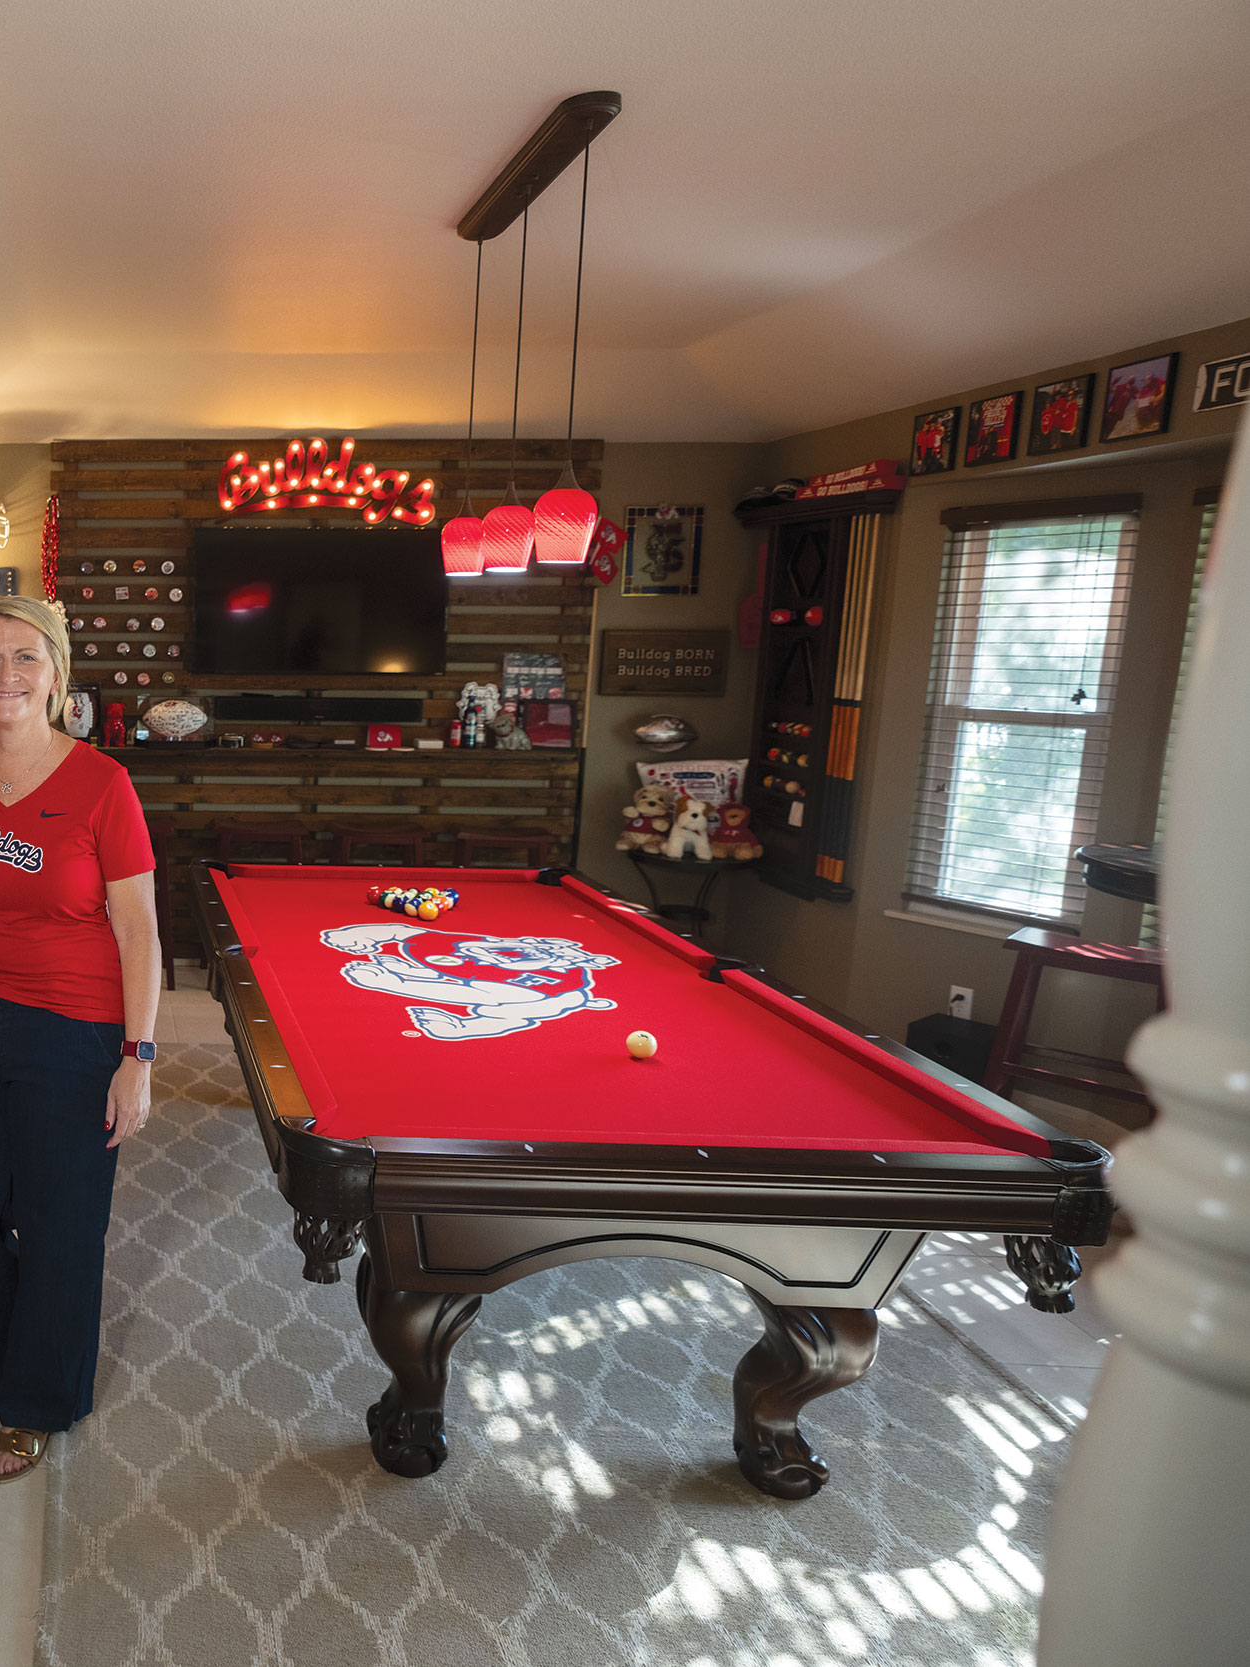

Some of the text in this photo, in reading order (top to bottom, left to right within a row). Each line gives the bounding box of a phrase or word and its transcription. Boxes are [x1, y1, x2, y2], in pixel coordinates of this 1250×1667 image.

[217, 436, 436, 526] Bulldogs
[816, 480, 869, 497] GO BULLDOGS!
[618, 648, 715, 662] Bulldog BORN
[618, 665, 712, 678] Bulldog BRED
